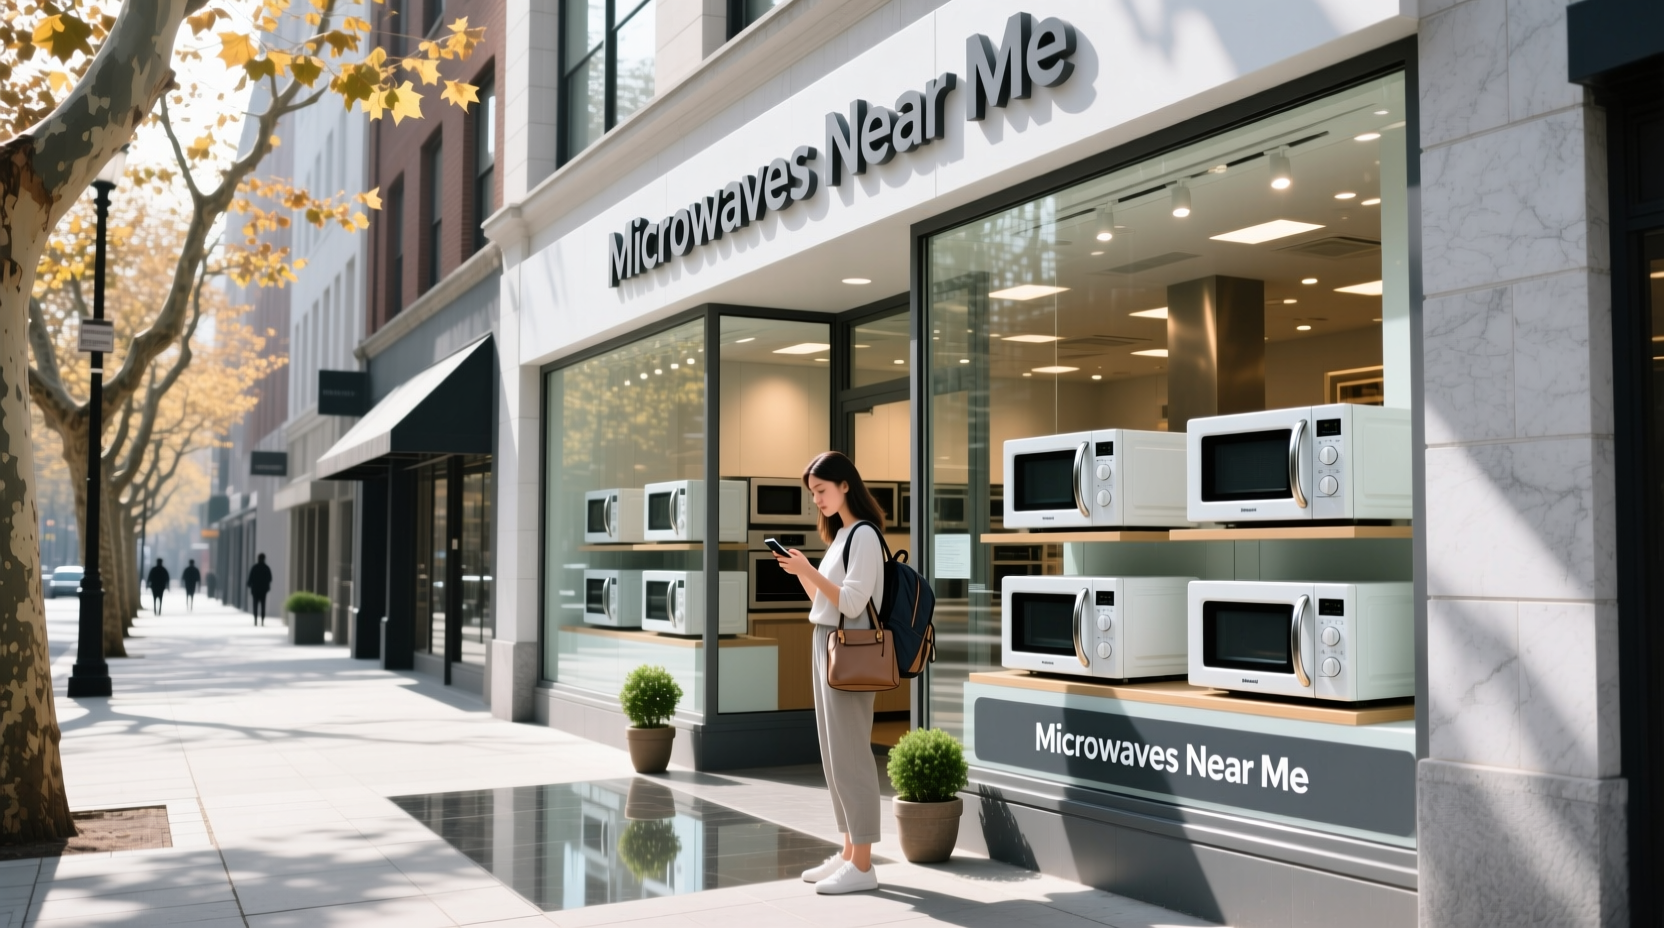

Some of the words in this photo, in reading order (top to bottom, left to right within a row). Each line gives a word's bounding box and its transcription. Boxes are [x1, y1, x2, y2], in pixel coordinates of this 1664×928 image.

[608, 145, 818, 288] Microwaves
[825, 72, 956, 187] Near
[966, 12, 1077, 122] Me
[1035, 722, 1179, 774] Microwaves
[1186, 743, 1254, 785] Near
[1261, 754, 1309, 794] Me
